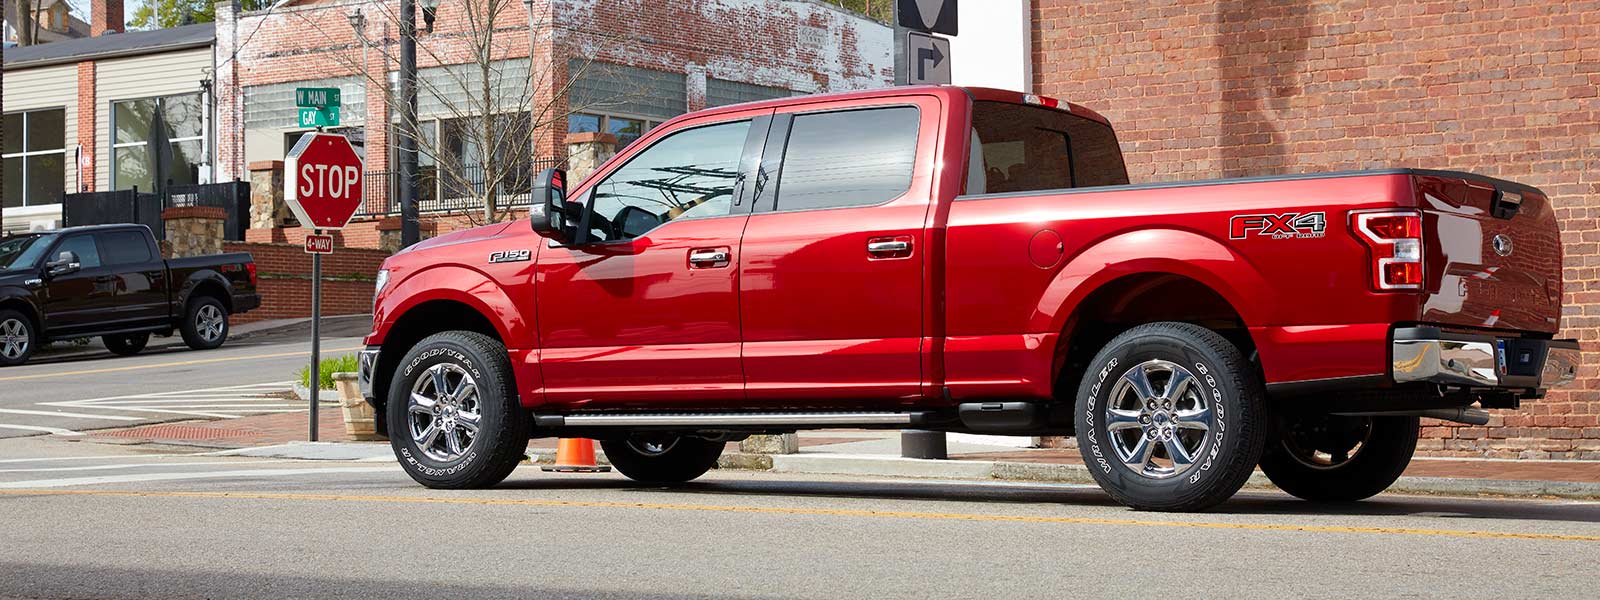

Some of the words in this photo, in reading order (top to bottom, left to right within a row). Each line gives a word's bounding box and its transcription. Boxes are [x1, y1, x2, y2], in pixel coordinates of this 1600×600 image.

[296, 91, 304, 105] W
[308, 91, 327, 105] MAIN
[302, 111, 317, 125] GAY
[300, 163, 359, 199] STOP
[1229, 211, 1327, 240] FX4
[307, 238, 331, 250] 4-WAY
[404, 348, 481, 379] GOODYEAR
[1086, 357, 1119, 474] WRANGLER
[1190, 362, 1226, 484] GOODYEAR
